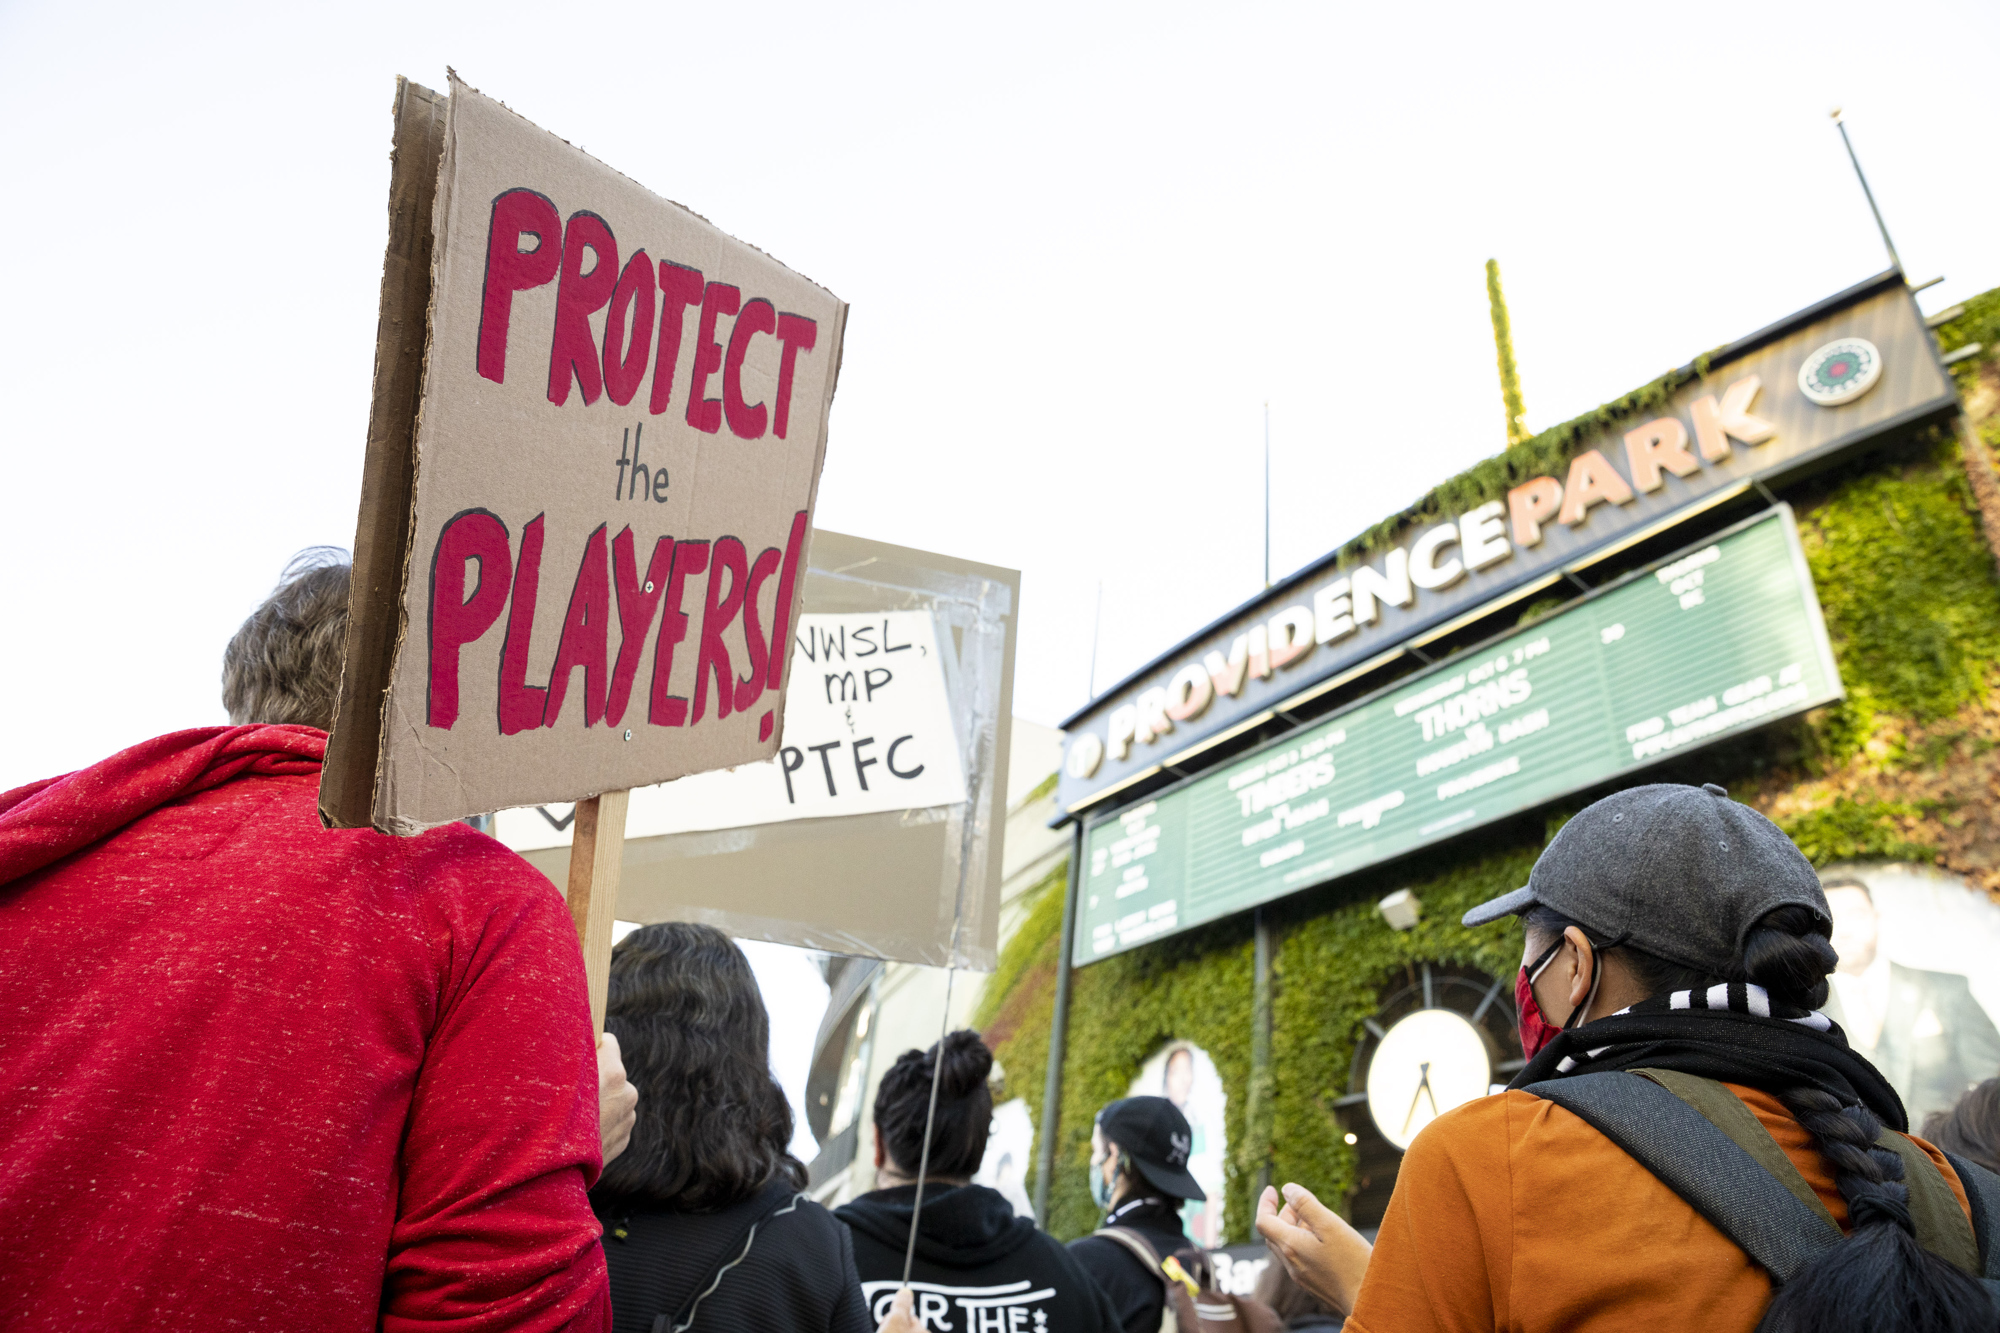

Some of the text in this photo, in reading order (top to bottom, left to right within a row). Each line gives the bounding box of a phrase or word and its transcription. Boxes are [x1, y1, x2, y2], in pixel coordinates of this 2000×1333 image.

[477, 187, 817, 439] PROTECT
[615, 421, 669, 503] the
[426, 507, 808, 742] PLAYERS!
[1106, 374, 1776, 761] PROVIDENCE PARK
[780, 735, 924, 804] PTFC
[1414, 668, 1532, 741] THORNS
